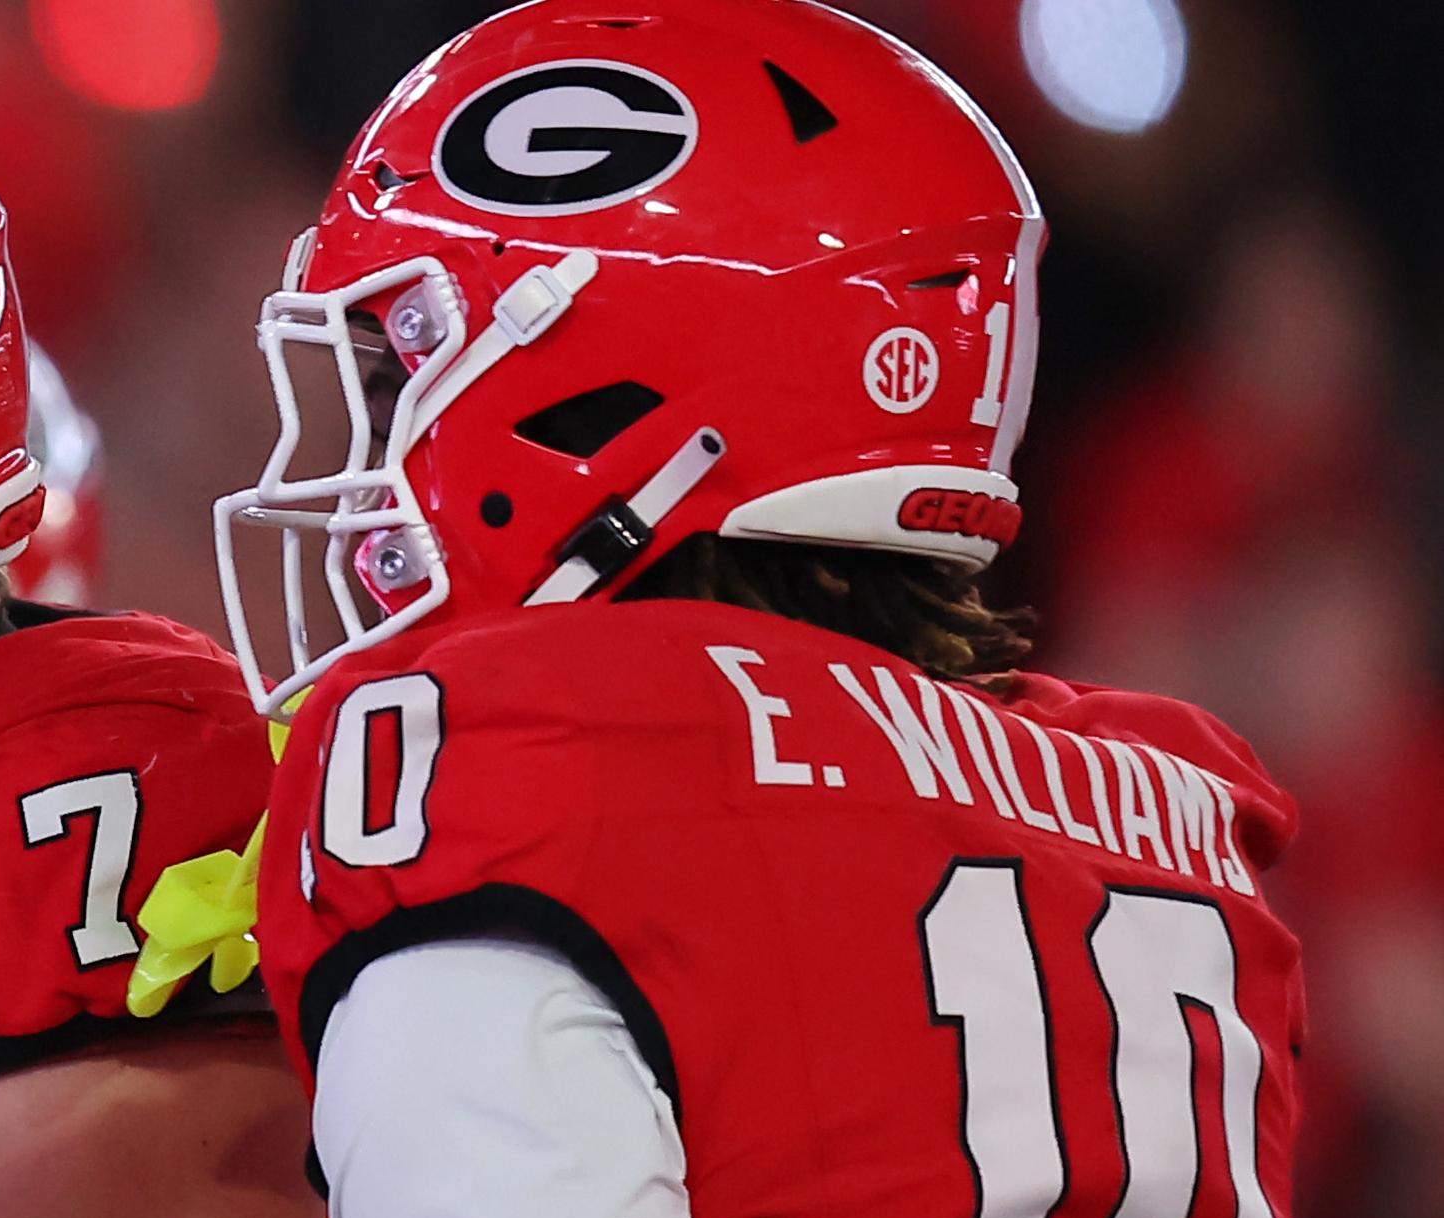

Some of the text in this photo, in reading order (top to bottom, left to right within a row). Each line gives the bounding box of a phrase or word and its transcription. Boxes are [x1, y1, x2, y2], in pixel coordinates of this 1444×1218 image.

[439, 64, 689, 209] G
[873, 335, 931, 404] SEC
[18, 768, 142, 972] 7
[299, 670, 445, 905] 0
[705, 645, 1256, 898] E. WILLIAMS
